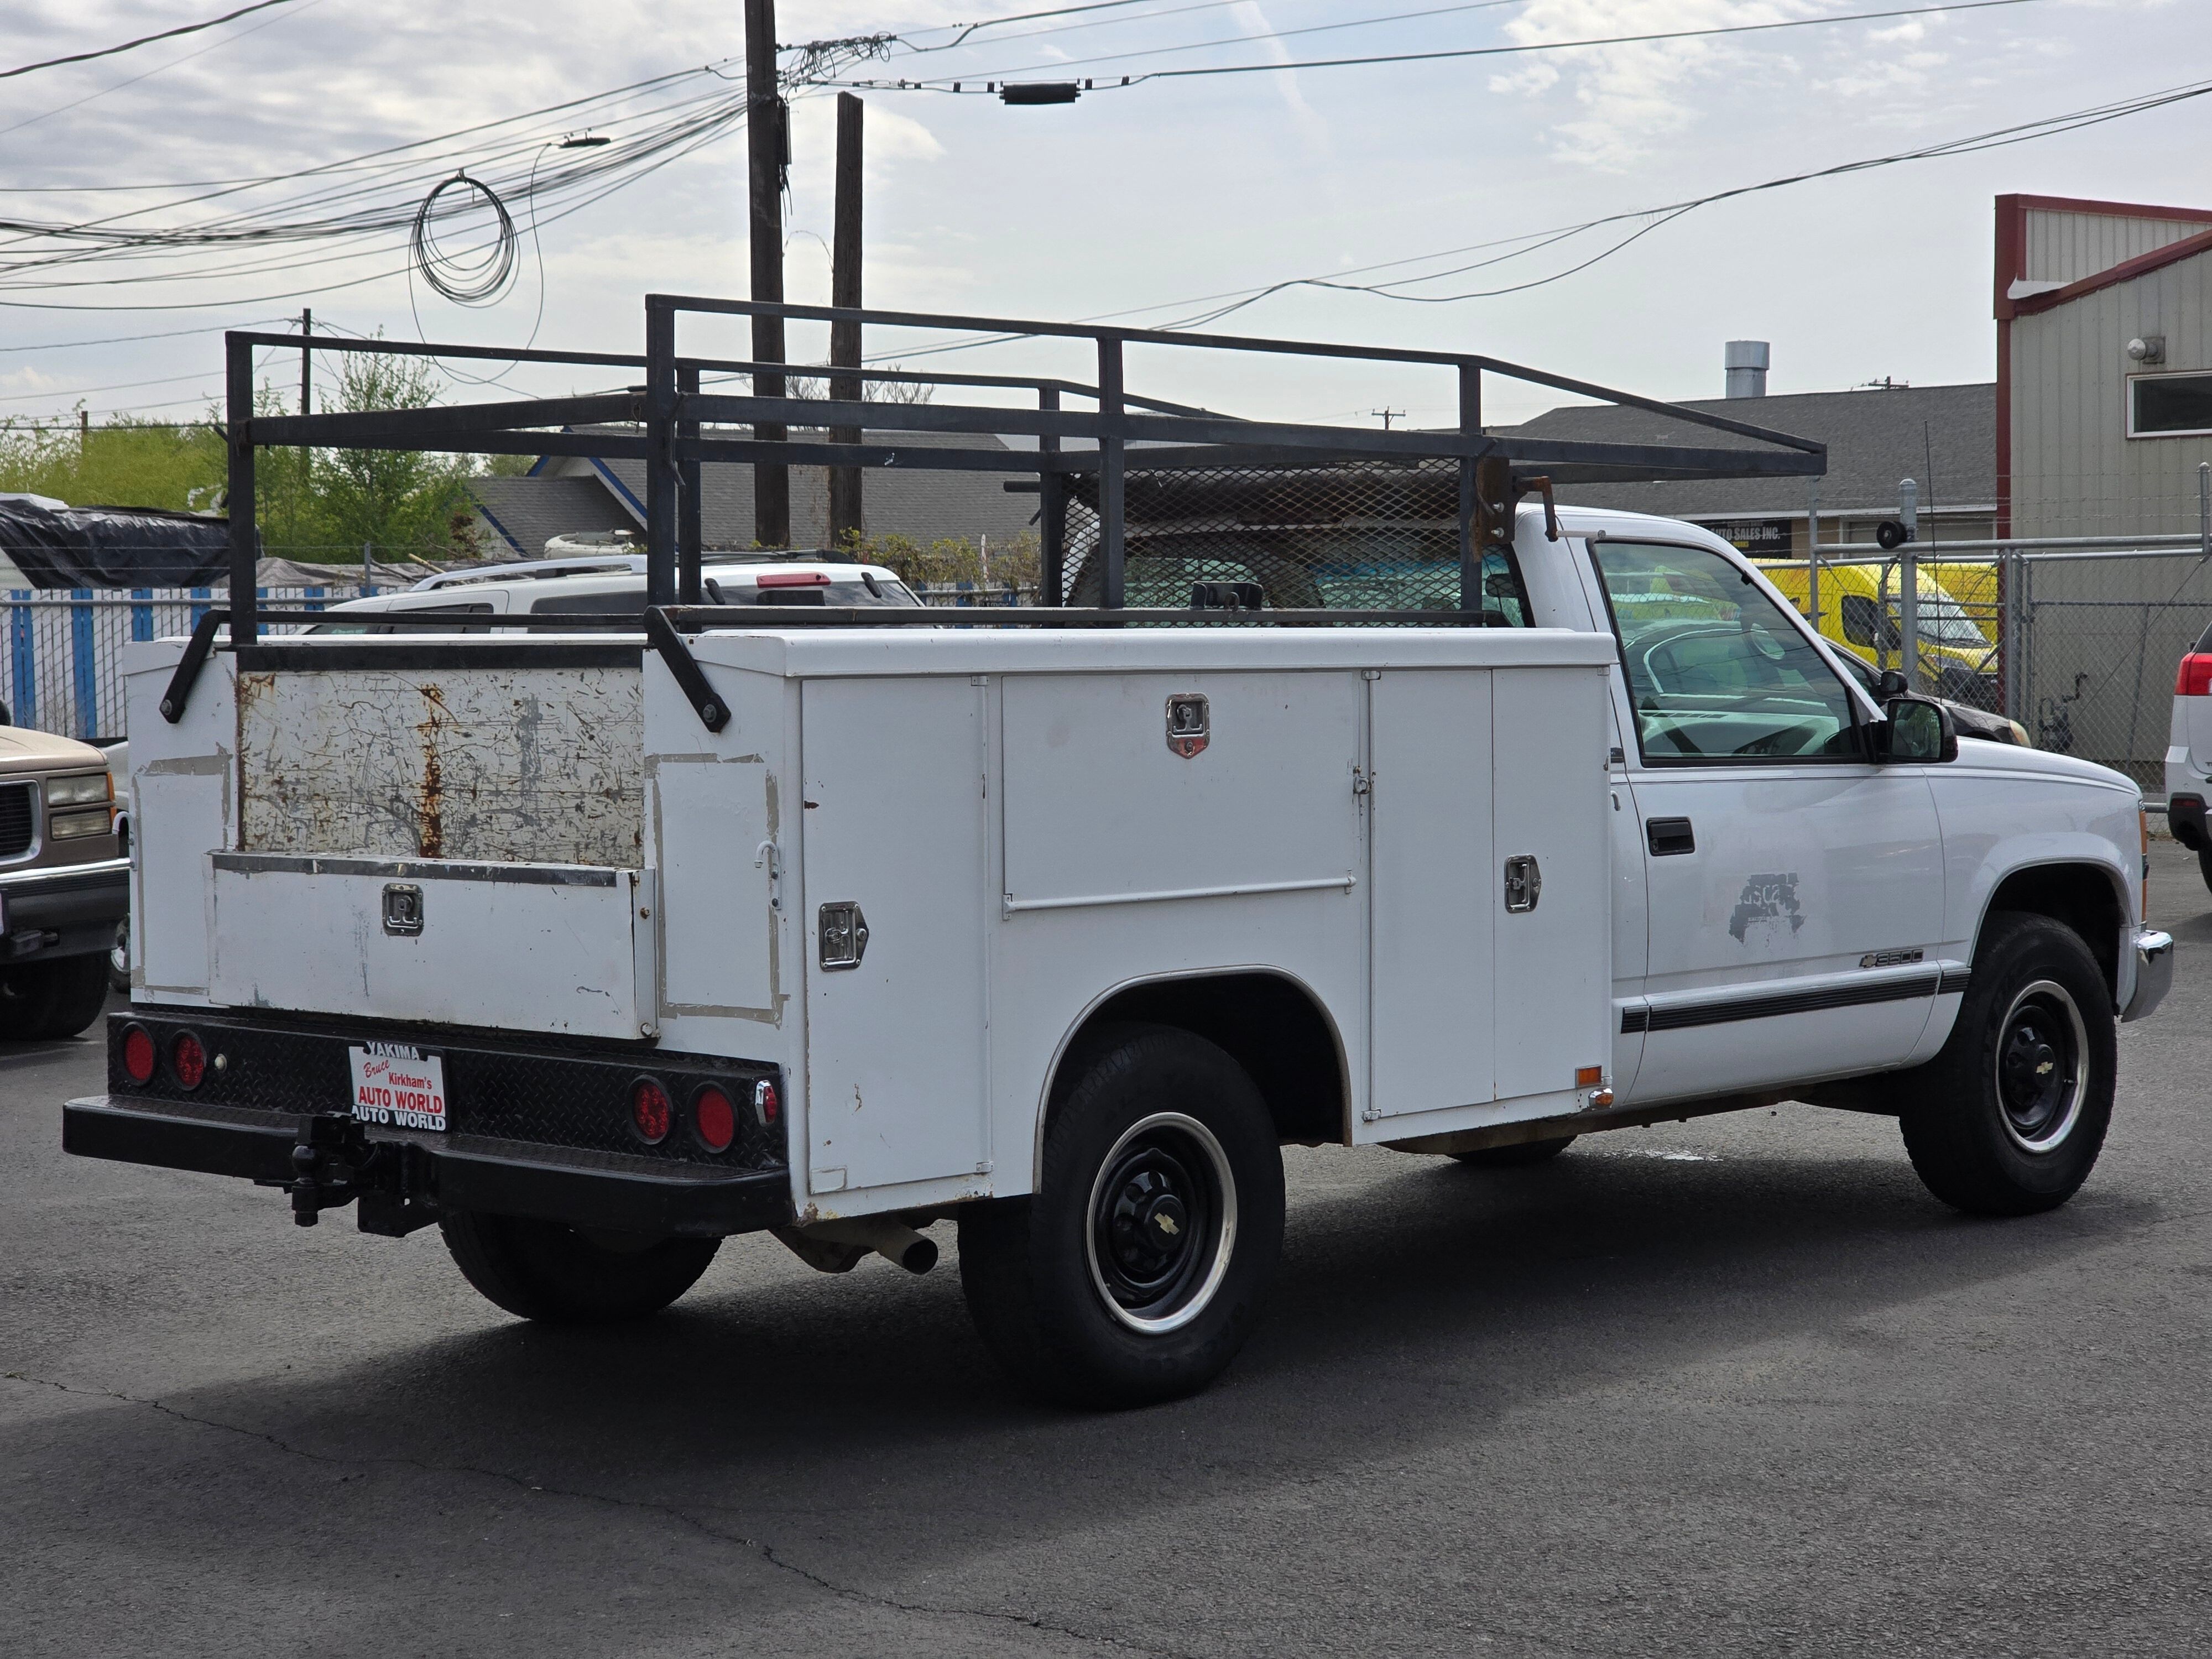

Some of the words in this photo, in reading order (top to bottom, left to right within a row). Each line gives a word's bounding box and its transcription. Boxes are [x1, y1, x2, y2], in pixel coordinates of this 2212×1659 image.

[1734, 527, 1760, 540] SALES
[1762, 526, 1780, 540] INC.
[366, 1041, 419, 1060] YAKIMA
[363, 1060, 390, 1078] Bruce
[389, 1072, 432, 1089] Kirkham's
[359, 1086, 391, 1107] AUTO
[395, 1090, 442, 1114] WORLD
[352, 1105, 389, 1124] AUTO
[394, 1111, 446, 1131] WORLD
